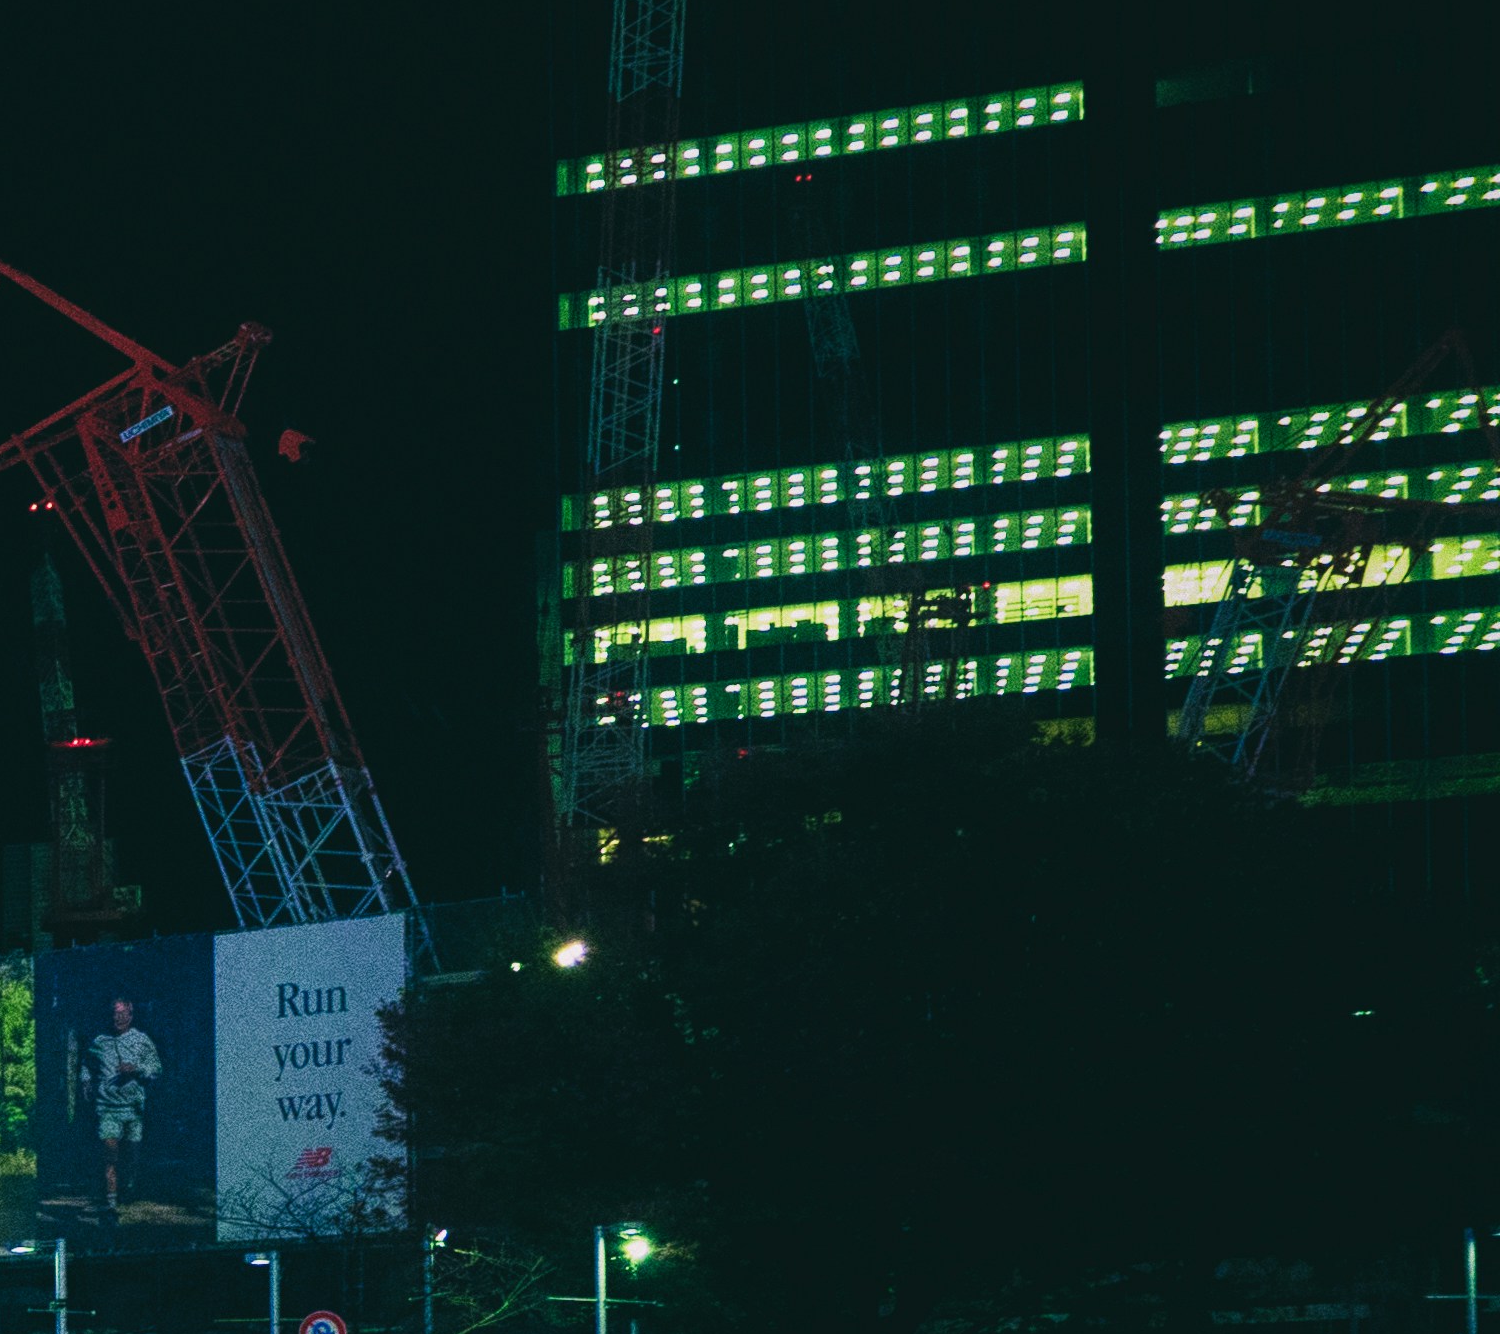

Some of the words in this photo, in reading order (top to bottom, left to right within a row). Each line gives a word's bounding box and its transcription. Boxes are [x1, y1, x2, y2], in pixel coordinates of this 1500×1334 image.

[276, 982, 350, 1018] Run
[272, 1038, 353, 1082] your
[276, 1092, 348, 1131] way.
